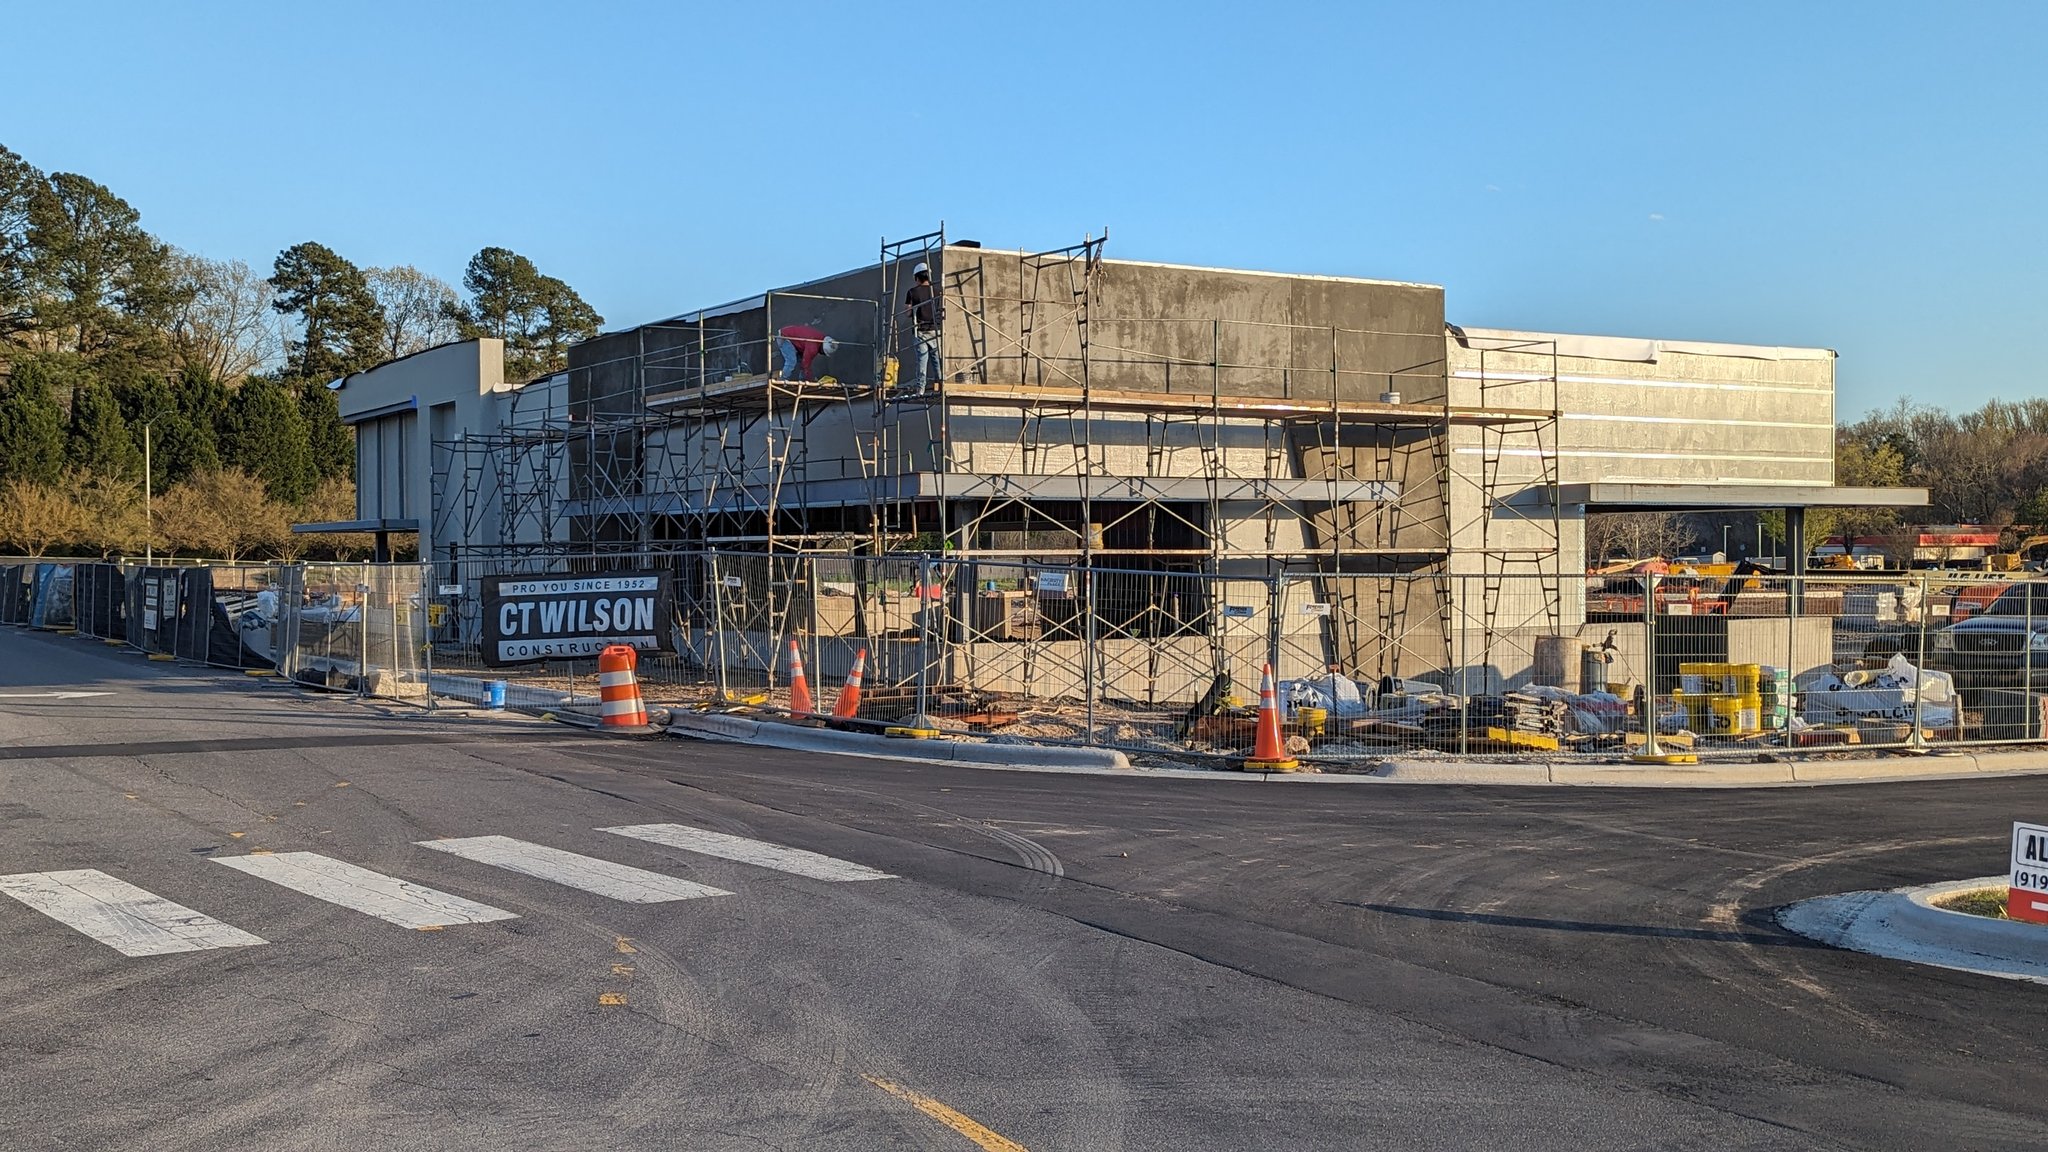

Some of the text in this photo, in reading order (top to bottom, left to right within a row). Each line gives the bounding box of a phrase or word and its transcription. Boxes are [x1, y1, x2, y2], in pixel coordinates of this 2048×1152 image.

[512, 579, 646, 594] PRO YOU SINCE 1952
[506, 640, 649, 657] CONSTRUCON
[2014, 869, 2048, 890] (919
